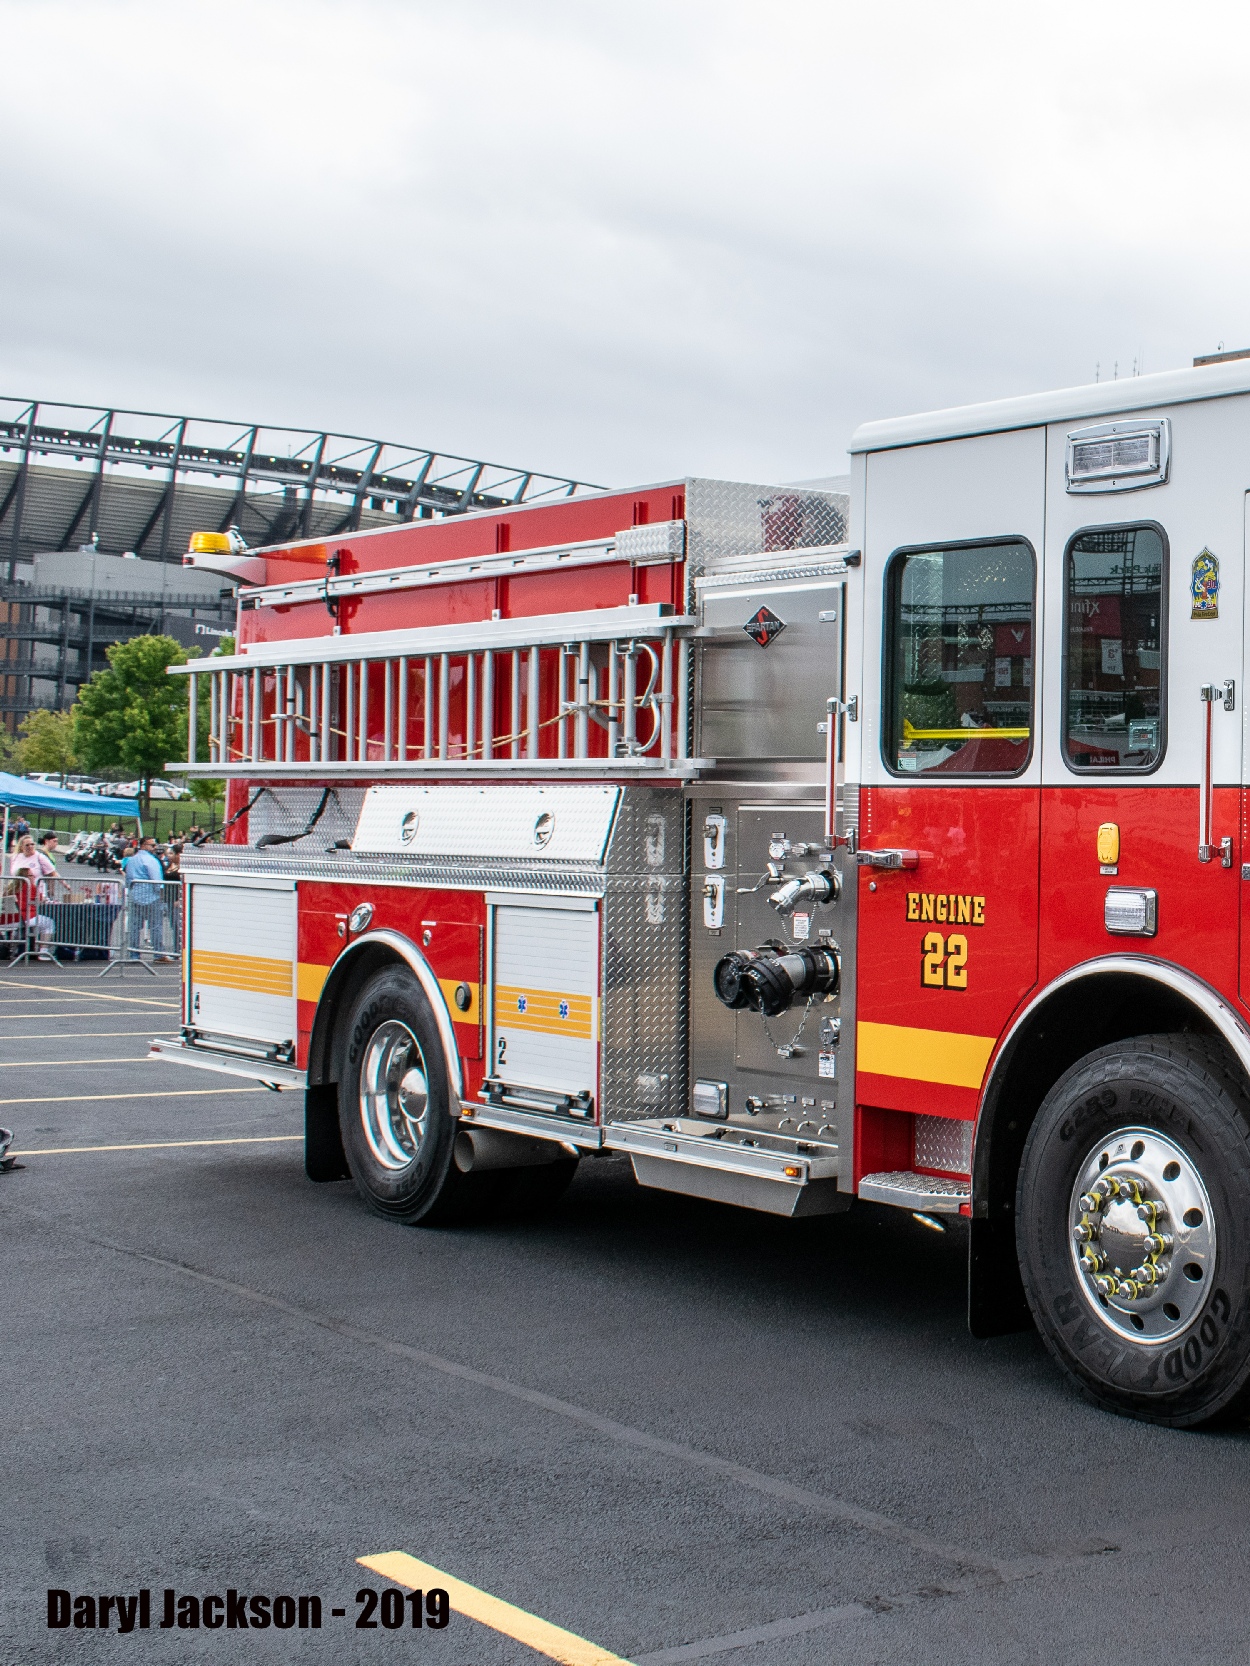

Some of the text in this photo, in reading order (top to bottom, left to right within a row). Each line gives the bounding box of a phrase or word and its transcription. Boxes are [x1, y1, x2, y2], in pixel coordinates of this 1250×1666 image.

[746, 621, 780, 633] SPARTAN
[906, 892, 985, 926] ENGINE
[921, 931, 968, 992] 22
[498, 1036, 506, 1065] 2
